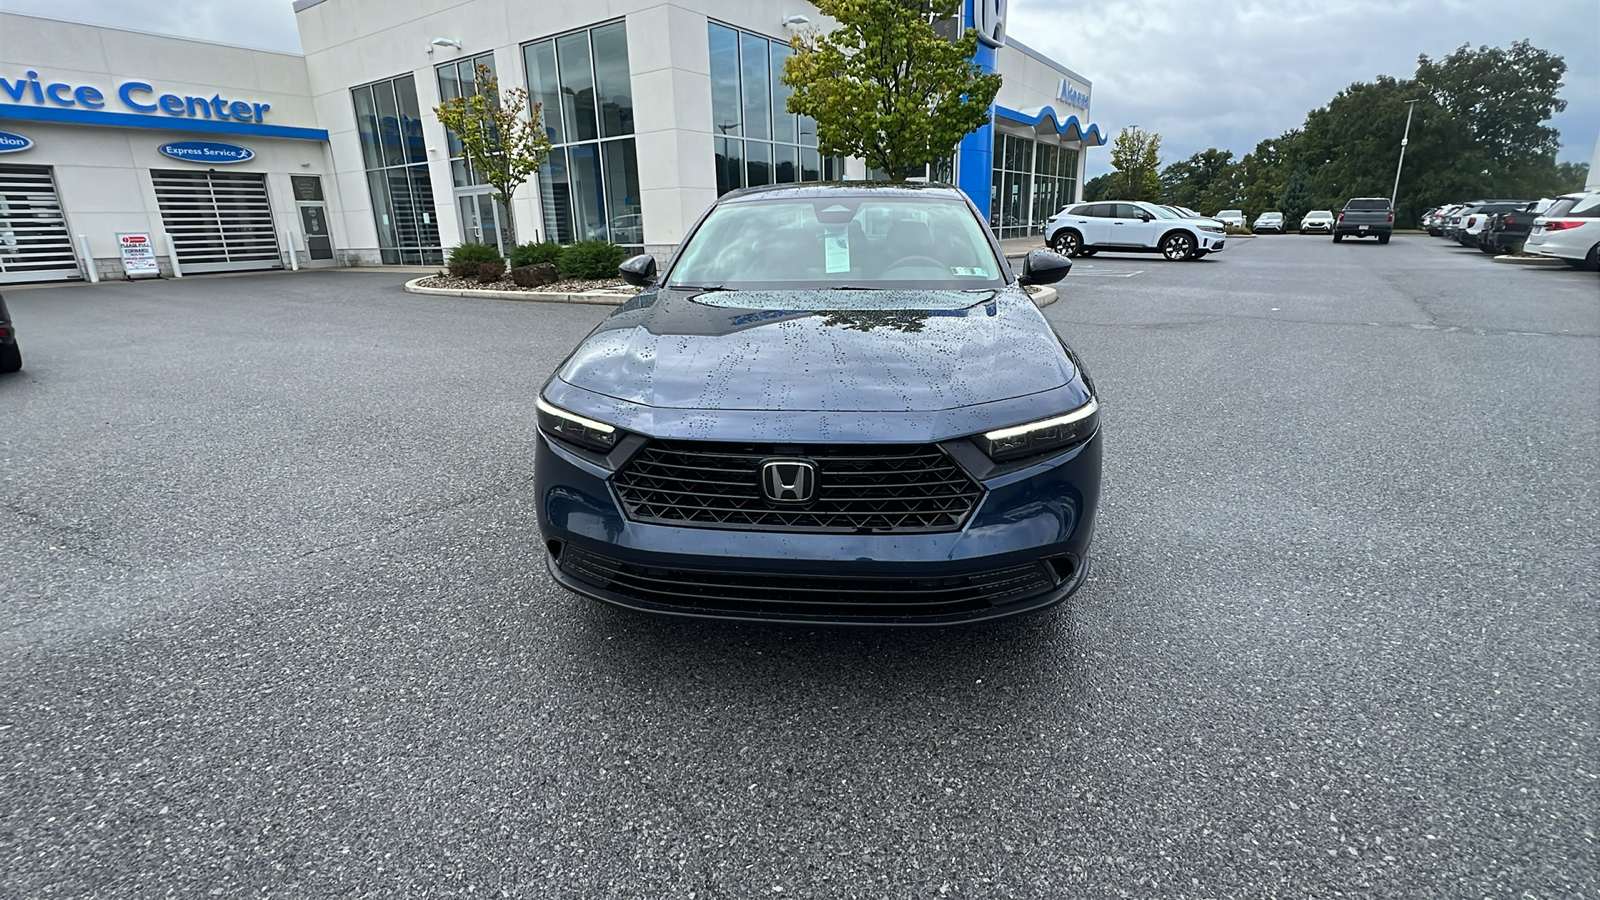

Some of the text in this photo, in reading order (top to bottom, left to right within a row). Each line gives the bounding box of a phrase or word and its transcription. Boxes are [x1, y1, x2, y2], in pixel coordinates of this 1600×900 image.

[118, 81, 271, 123] Center
[165, 146, 237, 157] Express Service
